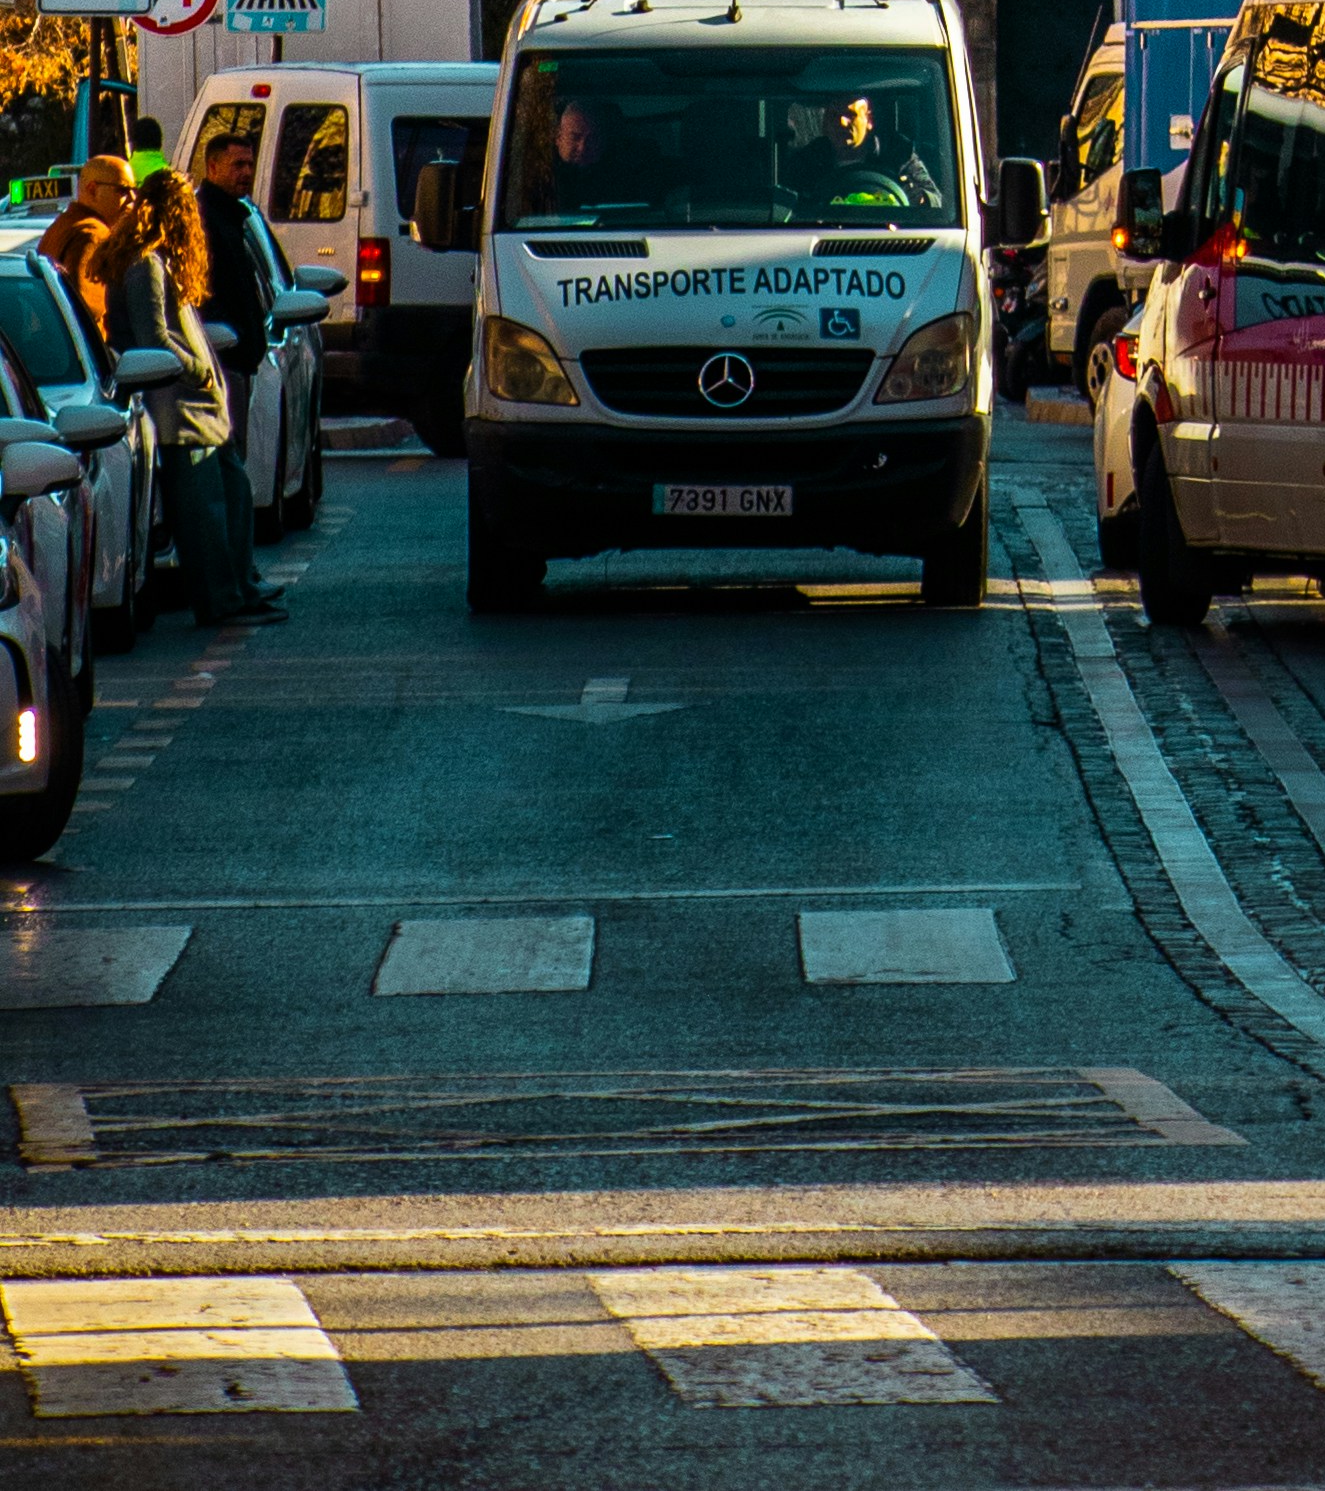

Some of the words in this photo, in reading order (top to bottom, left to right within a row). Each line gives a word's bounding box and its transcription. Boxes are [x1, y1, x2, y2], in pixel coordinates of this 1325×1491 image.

[25, 179, 60, 201] TAXI
[557, 268, 747, 307] TRANSPORTE
[753, 267, 906, 299] ADAPTADO
[739, 489, 788, 514] GNX
